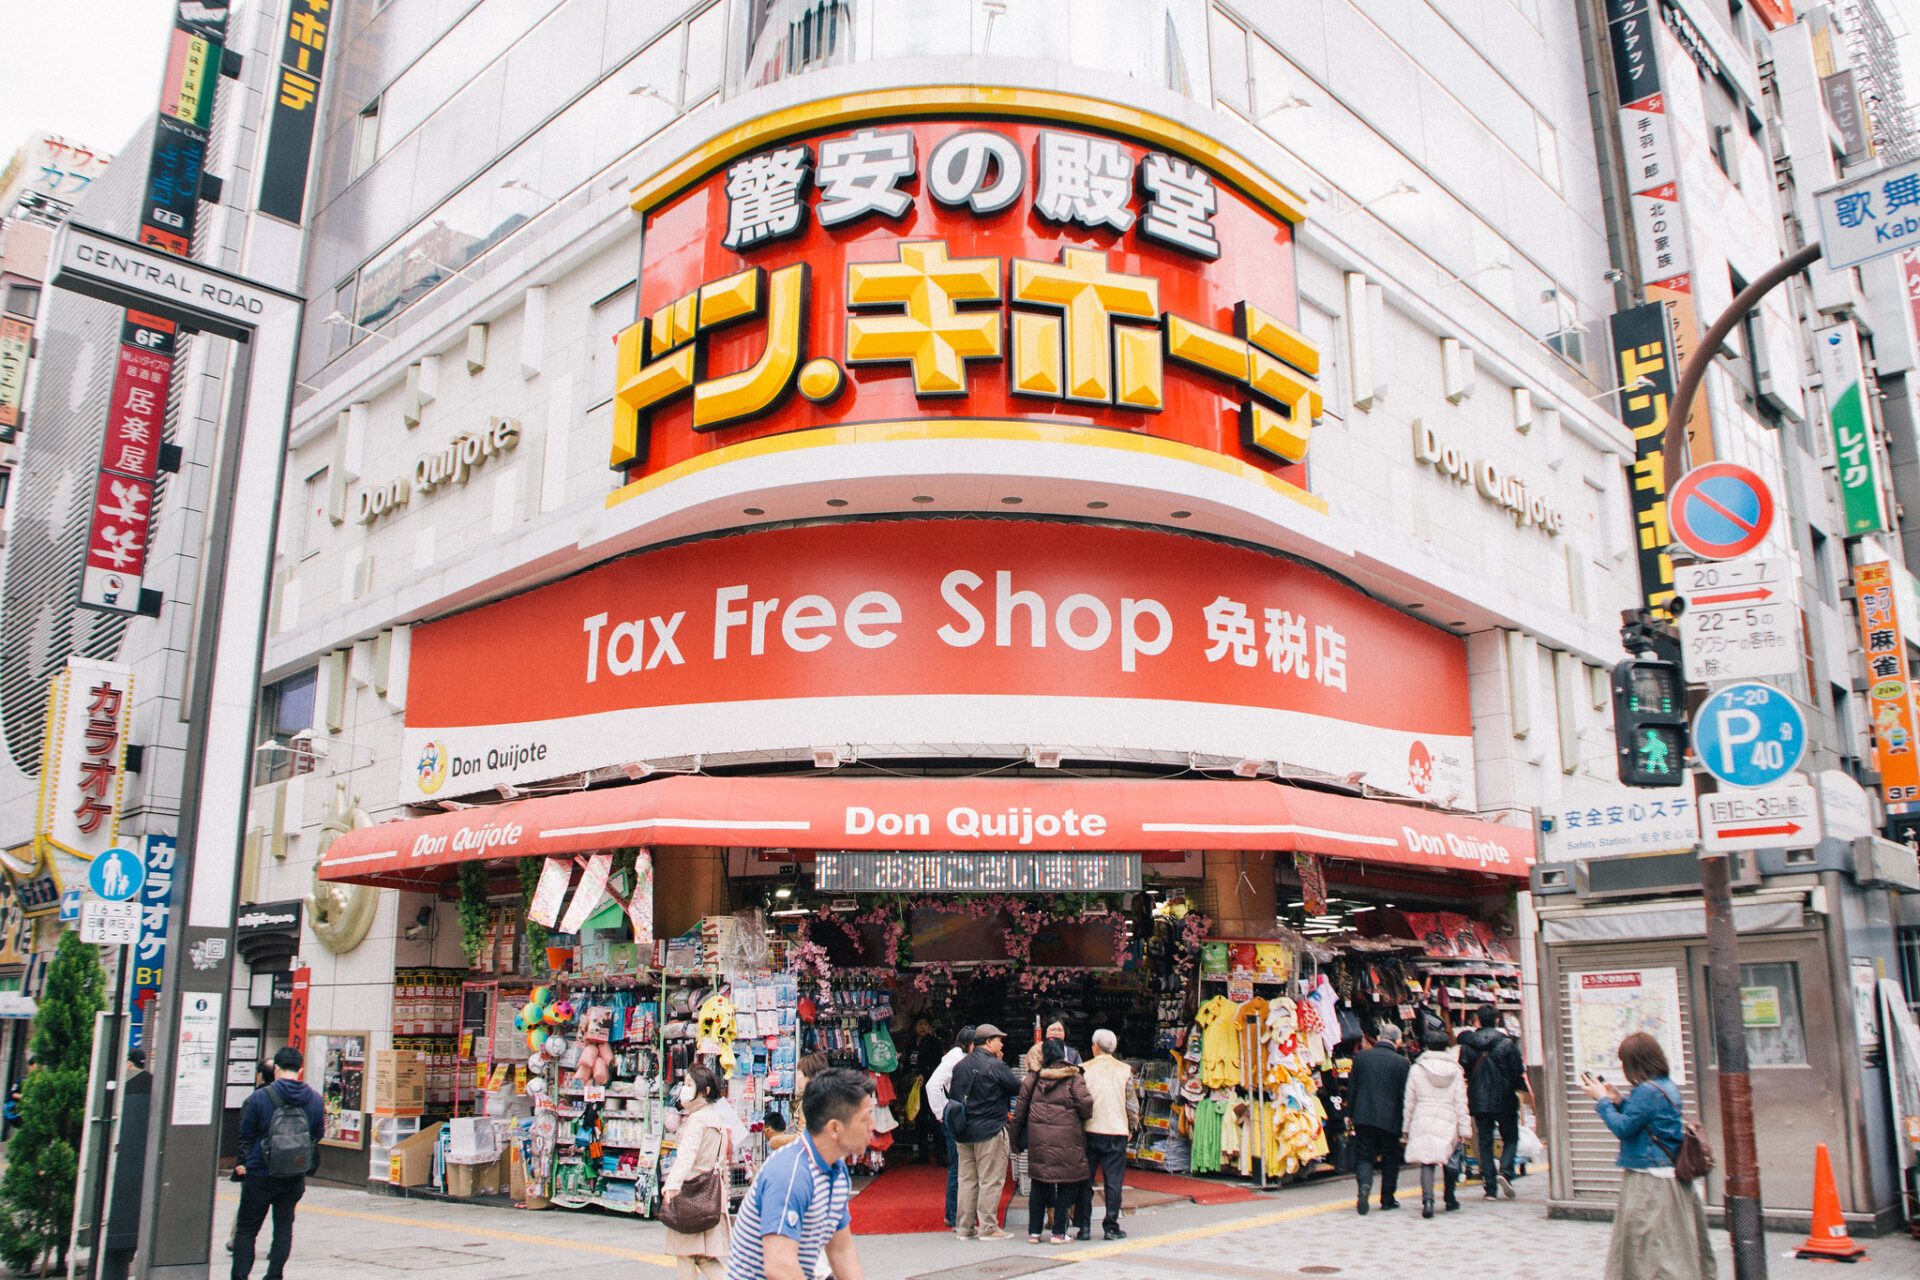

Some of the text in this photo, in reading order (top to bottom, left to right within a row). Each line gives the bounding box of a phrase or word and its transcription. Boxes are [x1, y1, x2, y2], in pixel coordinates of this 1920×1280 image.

[722, 129, 1221, 259] 驚安の殿堂
[157, 210, 180, 224] 7F
[1875, 216, 1920, 243] Kab
[77, 245, 192, 294] CENTRAL
[200, 283, 263, 315] ROAD
[135, 328, 165, 347] 6F
[116, 386, 155, 475] 居楽屋
[356, 416, 521, 525] Don Quijote
[1838, 427, 1868, 487] レイク
[1413, 418, 1564, 536] Don Quijote
[583, 569, 1348, 693] Tax Free Shop 免税店
[1692, 631, 1785, 655] タクシーの客待ち
[1694, 659, 1733, 677] を除く
[1869, 630, 1900, 678] 麻雀
[1722, 689, 1769, 708] 7-20
[74, 681, 123, 835] カラオケ
[1716, 708, 1761, 774] P
[1751, 740, 1784, 770] 40
[452, 742, 547, 778] Don Quijote
[1888, 786, 1917, 799] 3F
[845, 807, 1107, 844] Don Quijote
[1565, 798, 1697, 829] 安全安心ステ
[411, 821, 523, 858] Don Quijote
[1402, 825, 1511, 867] Don Quijote
[1567, 840, 1596, 850] Safety
[1600, 837, 1632, 847] Station
[139, 842, 176, 961] カラオケ
[136, 967, 162, 986] B1
